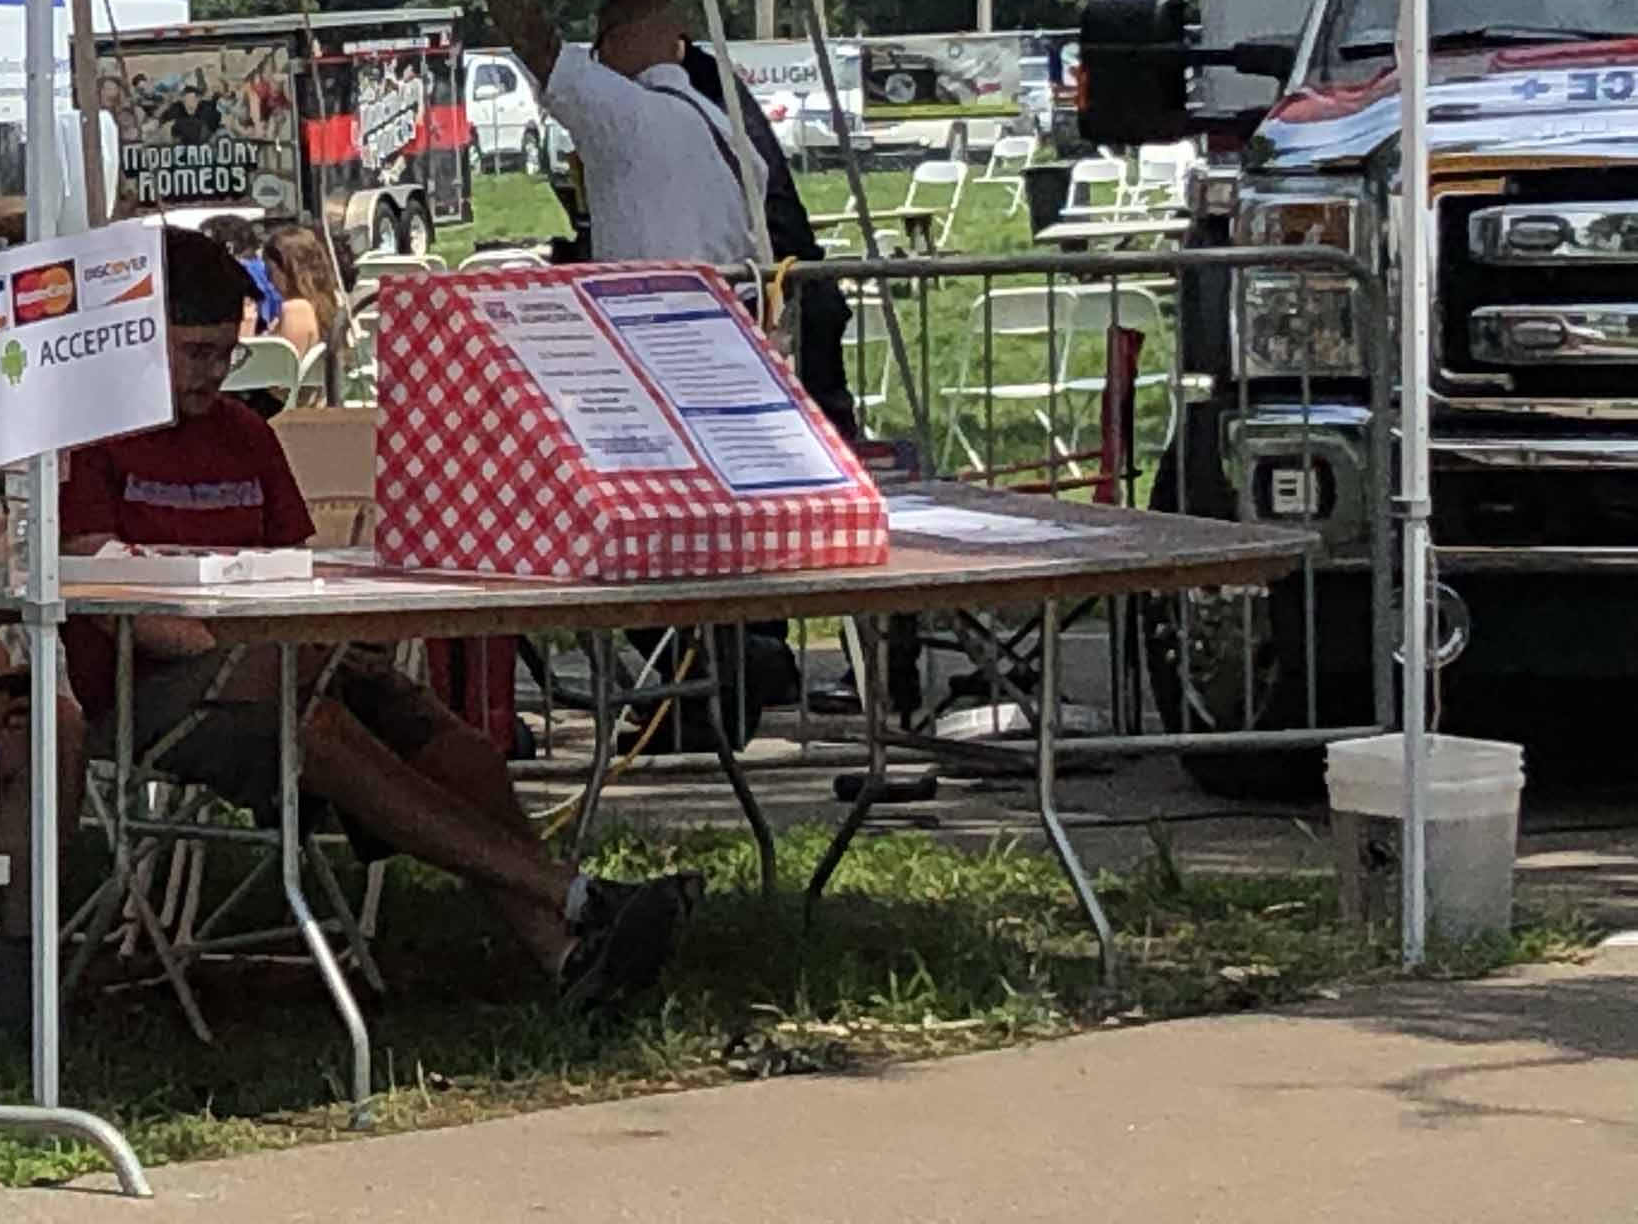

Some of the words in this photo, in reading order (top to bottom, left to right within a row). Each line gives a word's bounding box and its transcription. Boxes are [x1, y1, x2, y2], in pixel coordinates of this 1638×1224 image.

[138, 166, 247, 202] ROMEOS
[83, 255, 148, 283] DISCOVER
[39, 316, 157, 368] ACCEPTED
